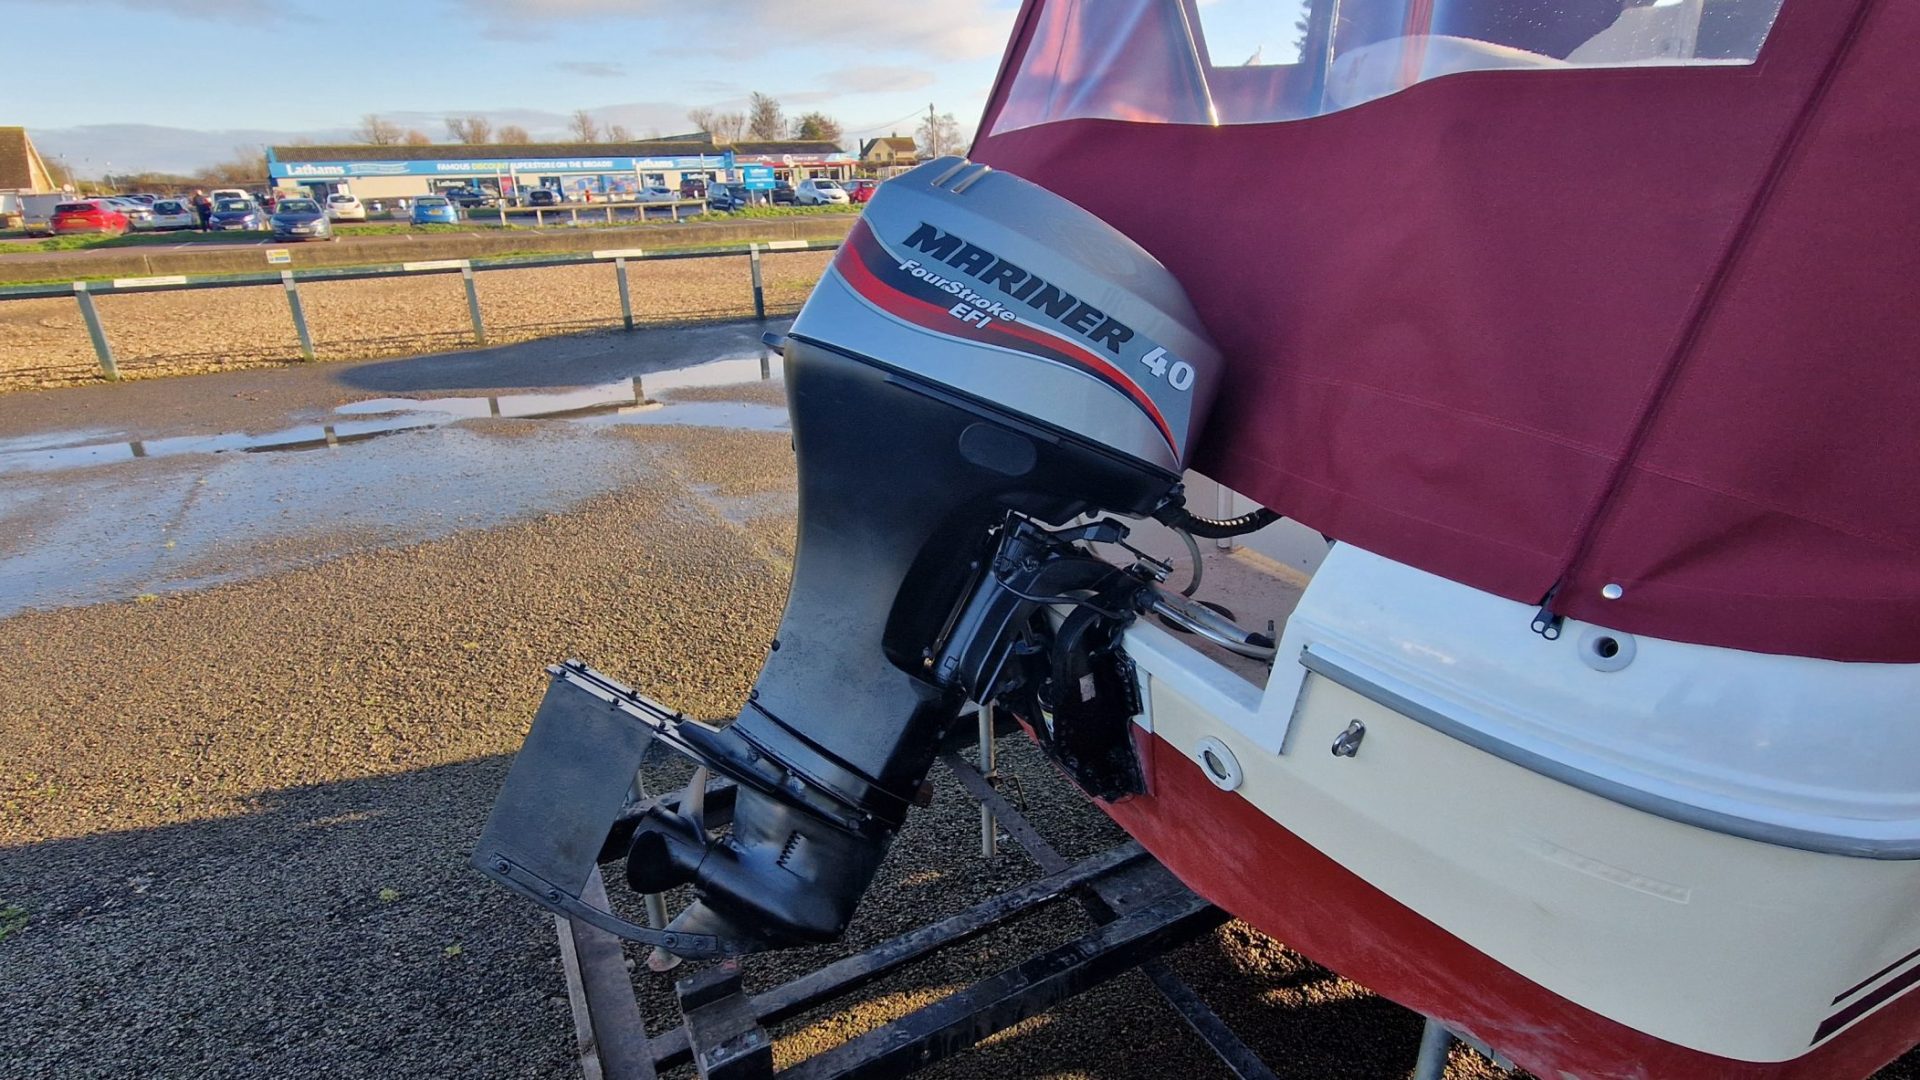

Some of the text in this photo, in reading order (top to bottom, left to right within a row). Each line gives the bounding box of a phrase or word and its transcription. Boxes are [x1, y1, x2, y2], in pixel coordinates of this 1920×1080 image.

[286, 163, 345, 176] Lathams
[436, 163, 470, 171] FAMOUS
[899, 259, 1017, 323] FourStroke
[902, 222, 1135, 354] MARINER
[948, 303, 992, 329] EFI
[1140, 346, 1195, 391] 40
